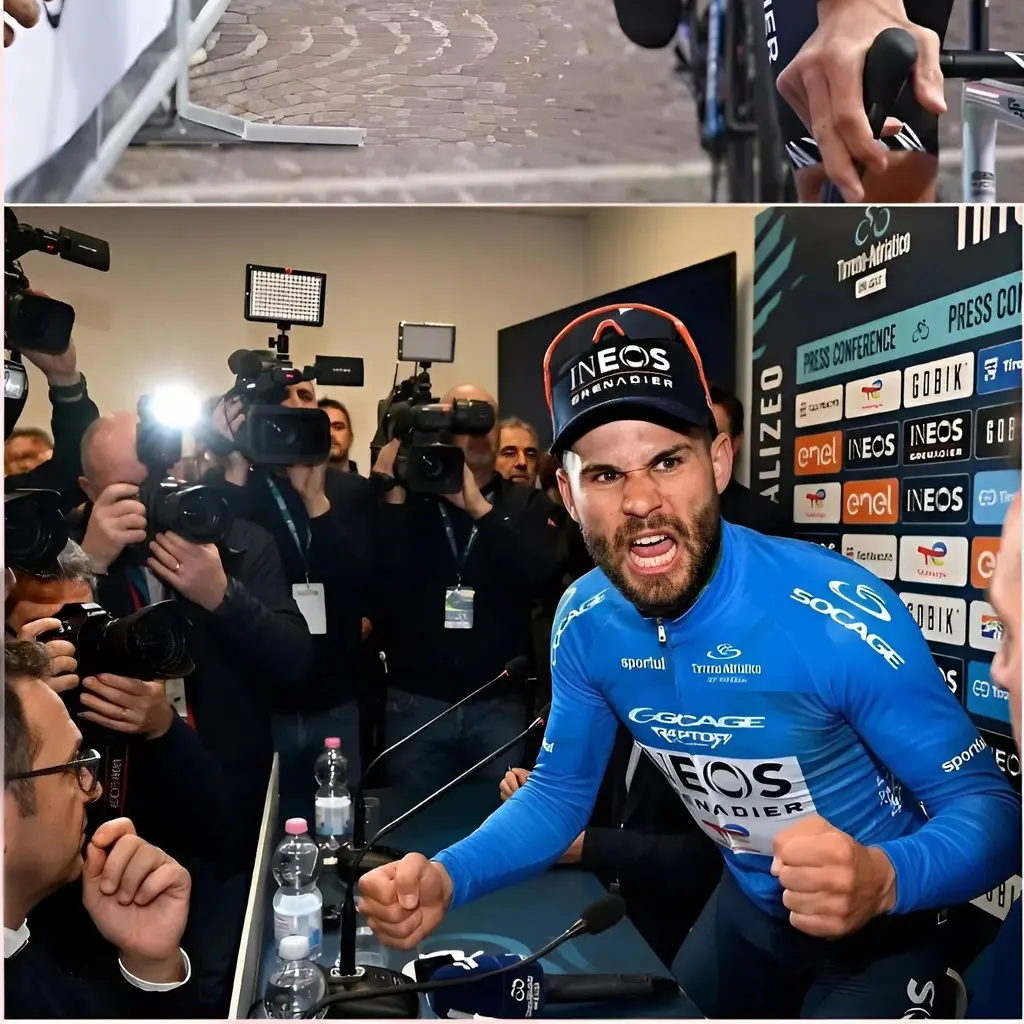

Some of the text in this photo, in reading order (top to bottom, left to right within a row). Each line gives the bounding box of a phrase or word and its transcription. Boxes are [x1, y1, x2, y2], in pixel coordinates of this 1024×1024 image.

[948, 292, 992, 333] PRESS
[570, 345, 671, 391] INEOS
[912, 363, 963, 399] GOBIK
[848, 433, 896, 461] INEOS
[910, 418, 963, 447] INEOS
[797, 436, 837, 468] enel
[847, 484, 892, 515] enel
[907, 486, 963, 512] INEOS
[790, 587, 905, 669] SOCAGE
